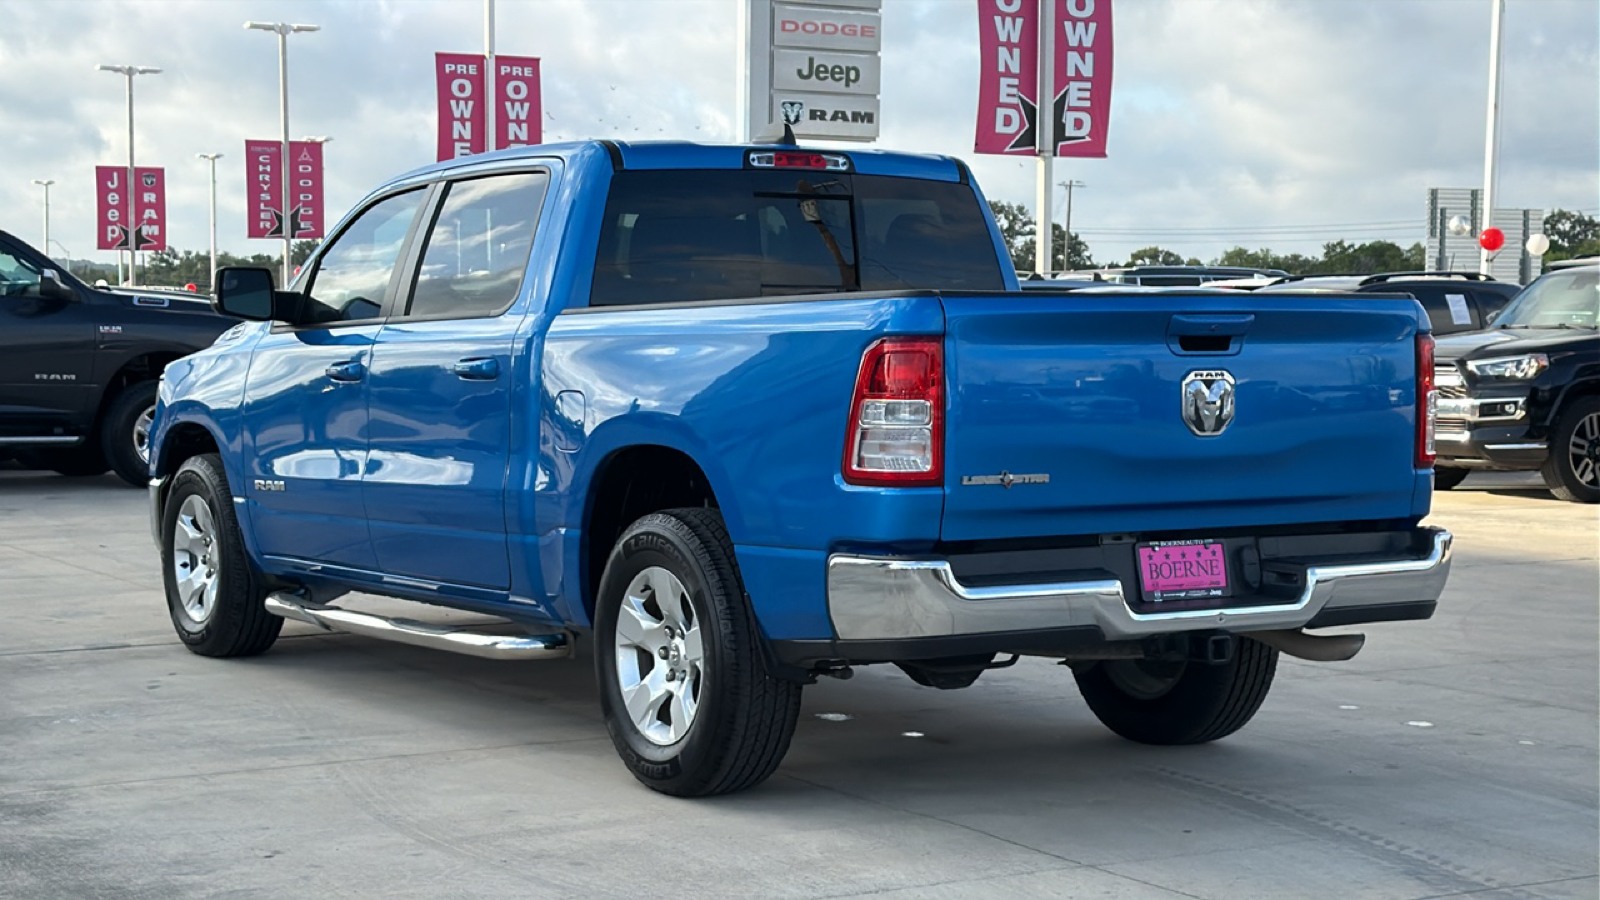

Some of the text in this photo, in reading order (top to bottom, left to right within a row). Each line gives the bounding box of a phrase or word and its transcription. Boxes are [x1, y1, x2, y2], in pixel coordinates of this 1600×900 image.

[781, 20, 876, 38] DODGE
[445, 63, 478, 75] PRE
[500, 65, 533, 77] PRE
[797, 56, 861, 88] Jeep
[1064, 0, 1097, 137] OWNED
[505, 80, 531, 148] OWN
[809, 109, 875, 124] RAM
[258, 155, 272, 229] CHRYSLER
[298, 165, 314, 229] DODGE
[107, 171, 120, 242] Jeep
[141, 192, 160, 236] RAM
[34, 373, 76, 381] RAM
[254, 479, 286, 491] RAM
[1148, 559, 1221, 580] BOERNE
